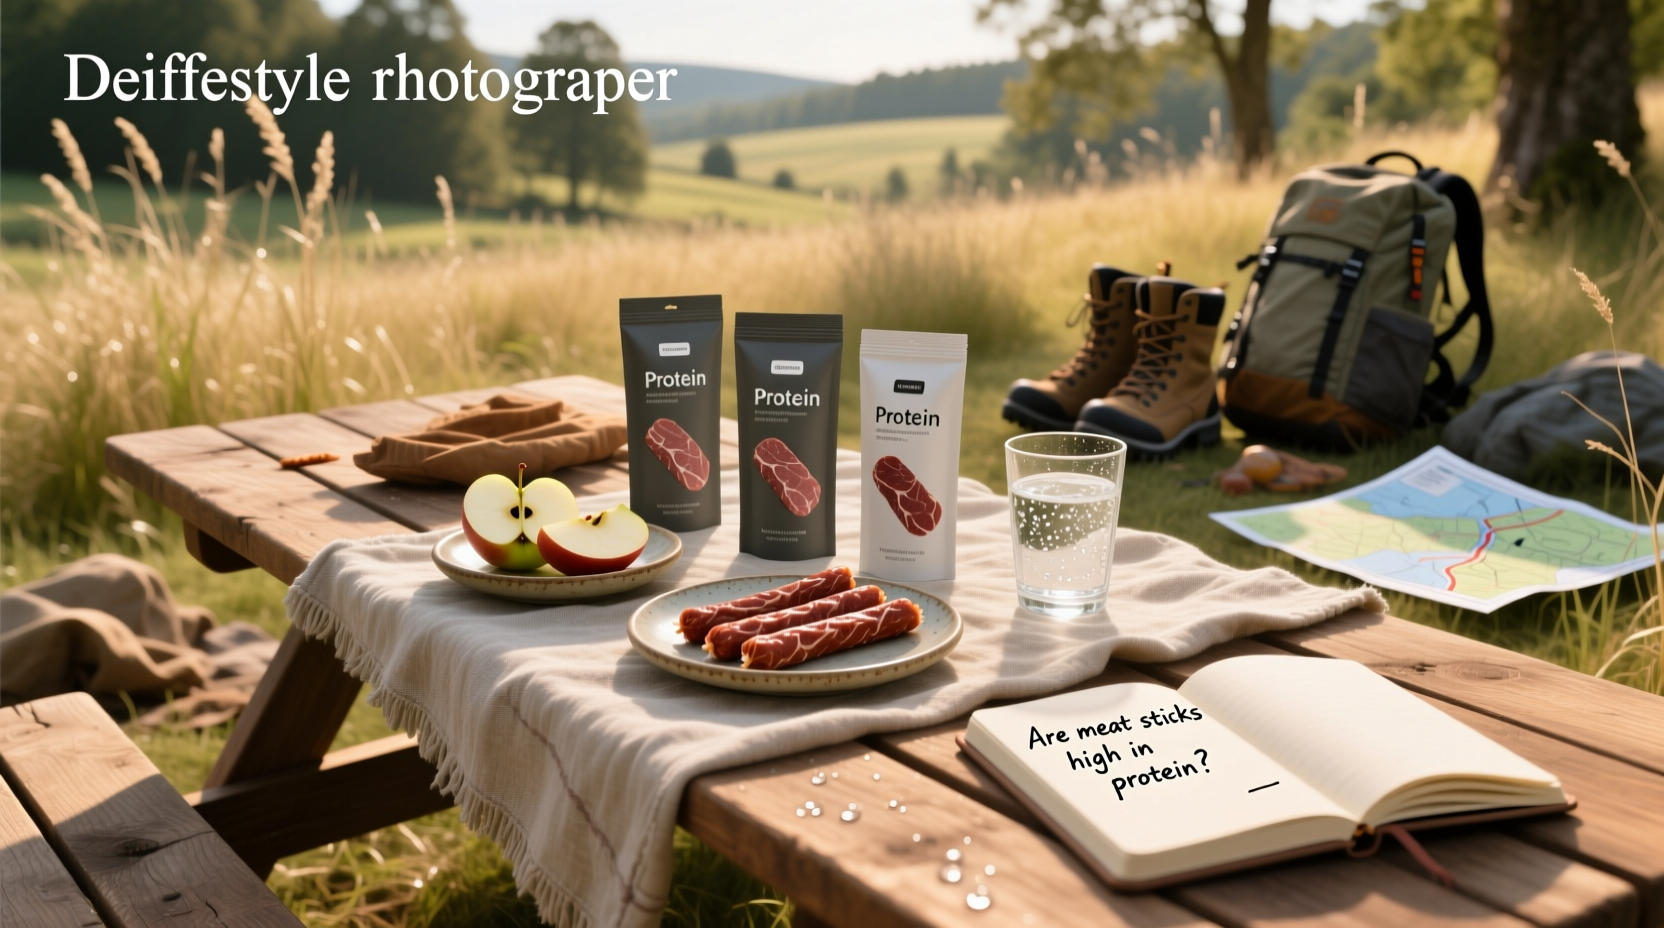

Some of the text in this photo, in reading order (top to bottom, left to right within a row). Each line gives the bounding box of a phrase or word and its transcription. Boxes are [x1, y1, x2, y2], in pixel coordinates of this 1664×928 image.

[645, 369, 706, 389] Protein
[754, 388, 820, 407] Protein
[875, 406, 940, 427] Protein
[1029, 704, 1203, 750] Are meat sticks
[1066, 741, 1154, 775] high in
[1111, 748, 1210, 801] protein?
